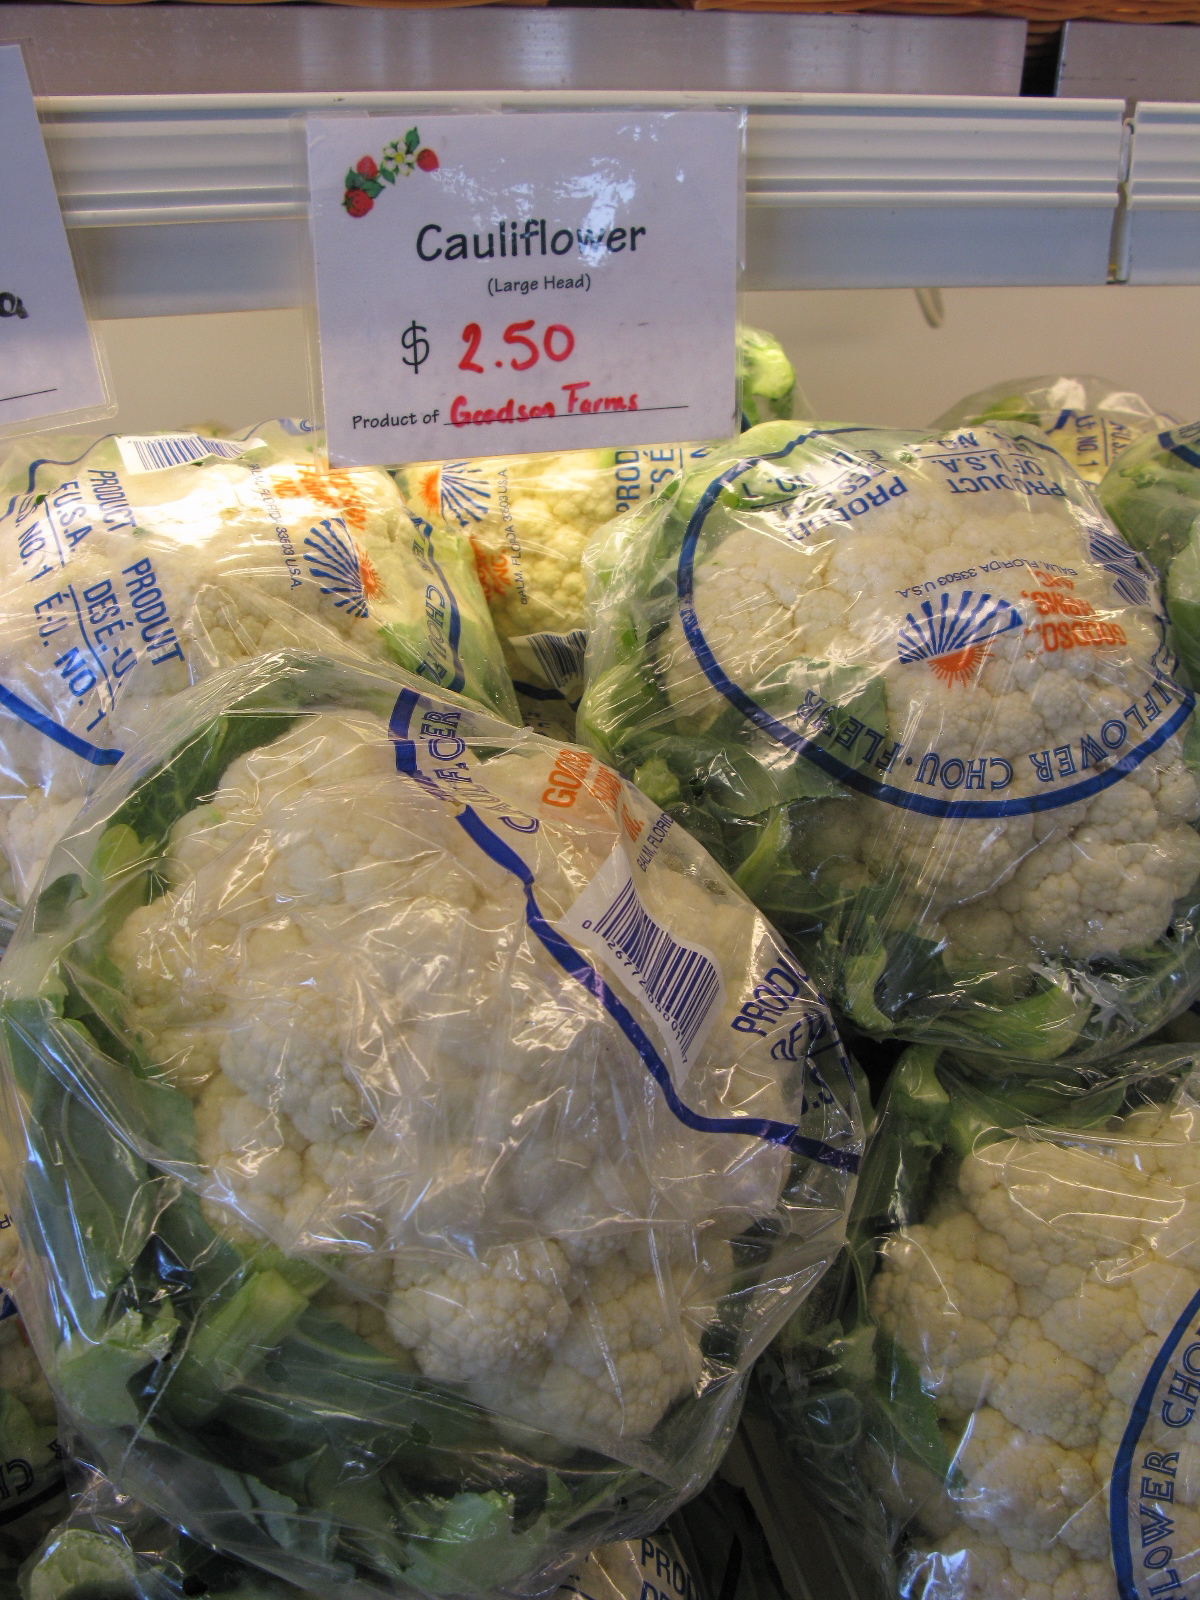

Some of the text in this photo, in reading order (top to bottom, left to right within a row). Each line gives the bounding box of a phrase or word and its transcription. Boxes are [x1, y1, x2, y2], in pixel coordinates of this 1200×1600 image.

[415, 217, 647, 262] Cauliflower
[486, 271, 592, 298] (Large Head)
[400, 318, 576, 375] $ 2.50
[352, 413, 418, 430] Product
[421, 410, 440, 428] of
[561, 381, 639, 414] Farms
[614, 450, 641, 513] PROD
[931, 453, 1010, 474] U.S.A.
[87, 468, 136, 532] PRODUCT
[945, 473, 1068, 497] PRODUCT
[936, 565, 978, 586] 33503
[980, 556, 1038, 574] FLORIDA
[894, 580, 937, 600] U.S.A.
[121, 557, 186, 667] PRODUIT
[54, 645, 98, 707] NO.
[85, 709, 107, 732] 1
[647, 812, 675, 850] FLORID
